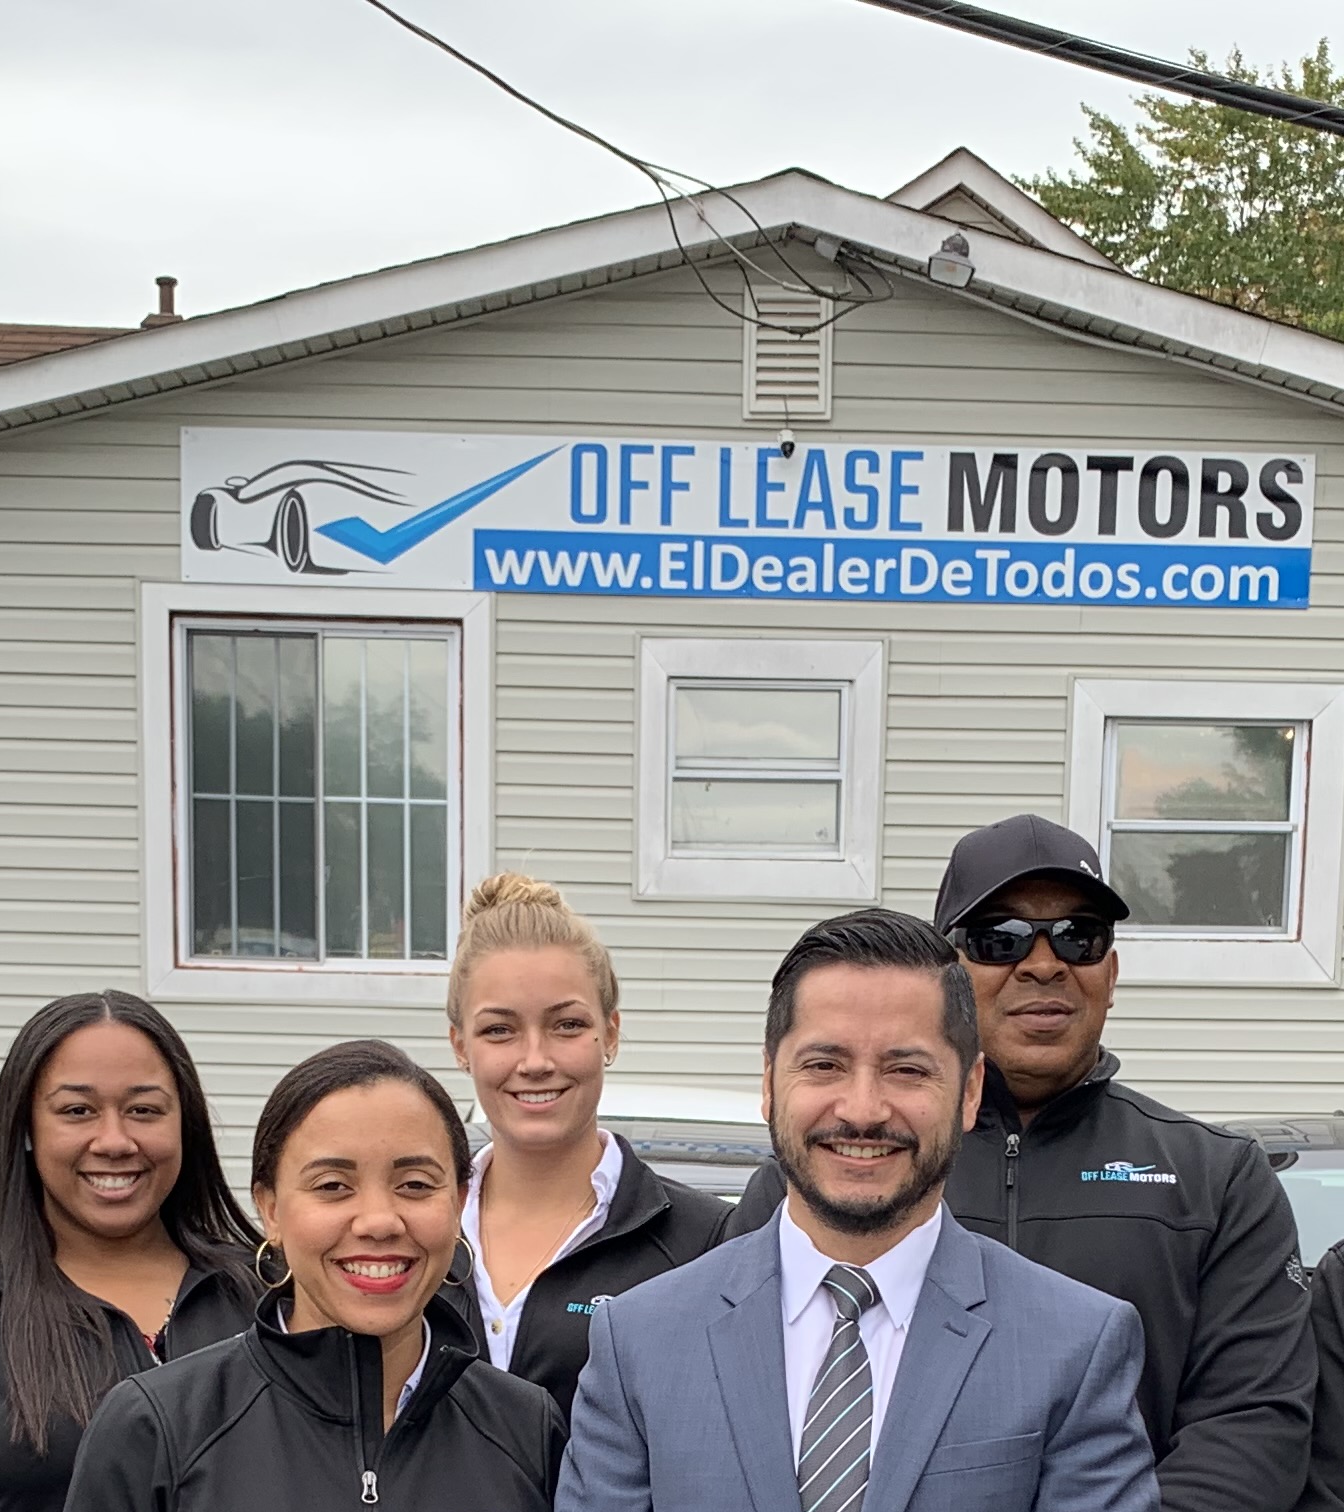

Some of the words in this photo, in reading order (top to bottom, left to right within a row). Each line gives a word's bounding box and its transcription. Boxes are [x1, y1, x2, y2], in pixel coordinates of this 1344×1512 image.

[569, 442, 696, 528] OFF
[717, 446, 925, 532] LEASE
[946, 451, 1305, 542] MOTORS
[483, 539, 1281, 603] www.ElDealerDeTodos.com
[1081, 1171, 1099, 1181] OFF
[1100, 1171, 1128, 1181] LEASE
[1129, 1172, 1177, 1184] MOTORS
[566, 1302, 583, 1313] OFF
